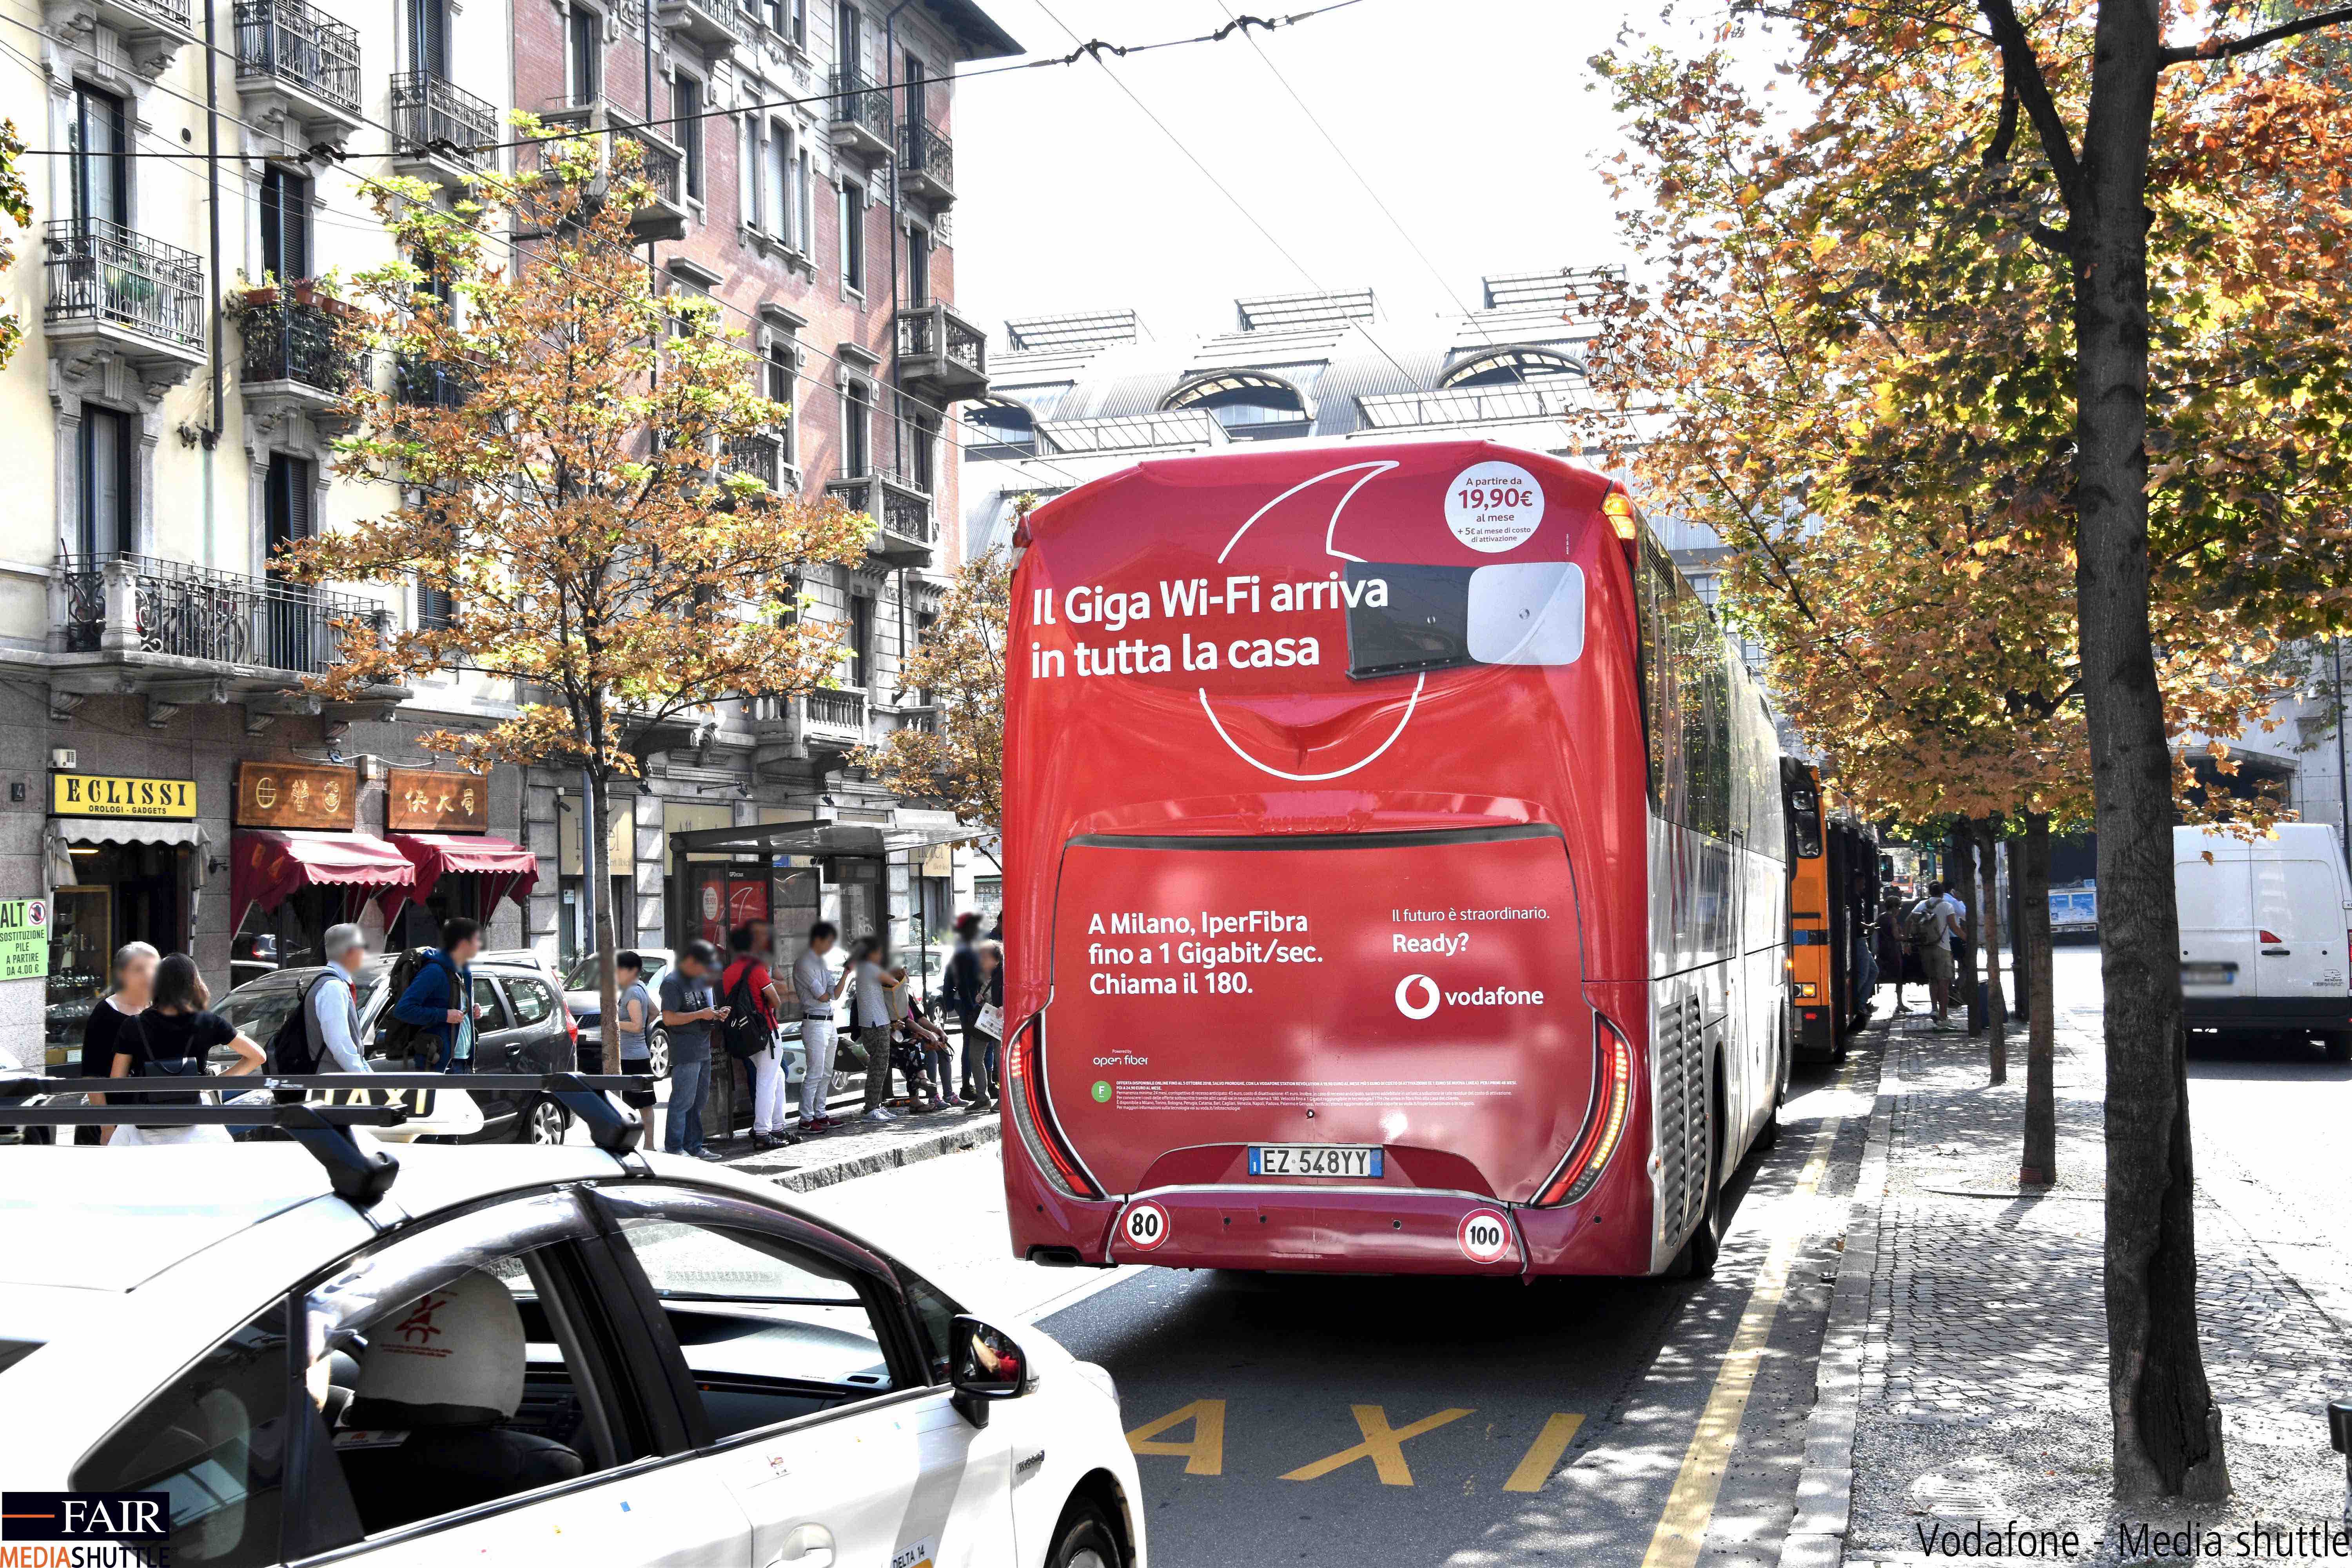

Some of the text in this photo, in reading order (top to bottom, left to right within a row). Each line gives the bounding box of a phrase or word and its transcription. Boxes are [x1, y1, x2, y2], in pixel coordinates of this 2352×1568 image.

[1476, 478, 1508, 487] partire
[1510, 477, 1522, 485] da
[1458, 488, 1533, 511] 19,90€
[1476, 514, 1486, 522] al
[1465, 527, 1475, 535] 5€
[1033, 571, 1388, 631] Il Giga Wi-Fi arriva
[1032, 633, 1319, 679] in tutta la casa
[66, 779, 186, 806] ECLISSI
[89, 805, 124, 813] OROLOGI
[0, 902, 24, 928] ALT
[1088, 911, 1308, 938] A Milano, IperFibra
[1392, 906, 1550, 922] Il futuro è straordinario.
[0, 929, 44, 942] SOSTITUZIONE
[1393, 932, 1469, 956] Ready?
[16, 942, 29, 952] PILE
[1088, 938, 1323, 969] fino a 1 Gigabit/sec.
[6, 953, 39, 964] A PARTIRE
[7, 964, 39, 976] DA 4.00 €
[1090, 972, 1253, 995] Chiama il 180.
[1445, 986, 1544, 1005] vodafone
[1093, 1055, 1148, 1067] open fiber
[1099, 1086, 1105, 1094] F
[1264, 1150, 1367, 1174] EZ 548YY
[1132, 1212, 1158, 1237] 80
[1470, 1225, 1499, 1247] 100
[893, 1544, 925, 1568] DELTA 14
